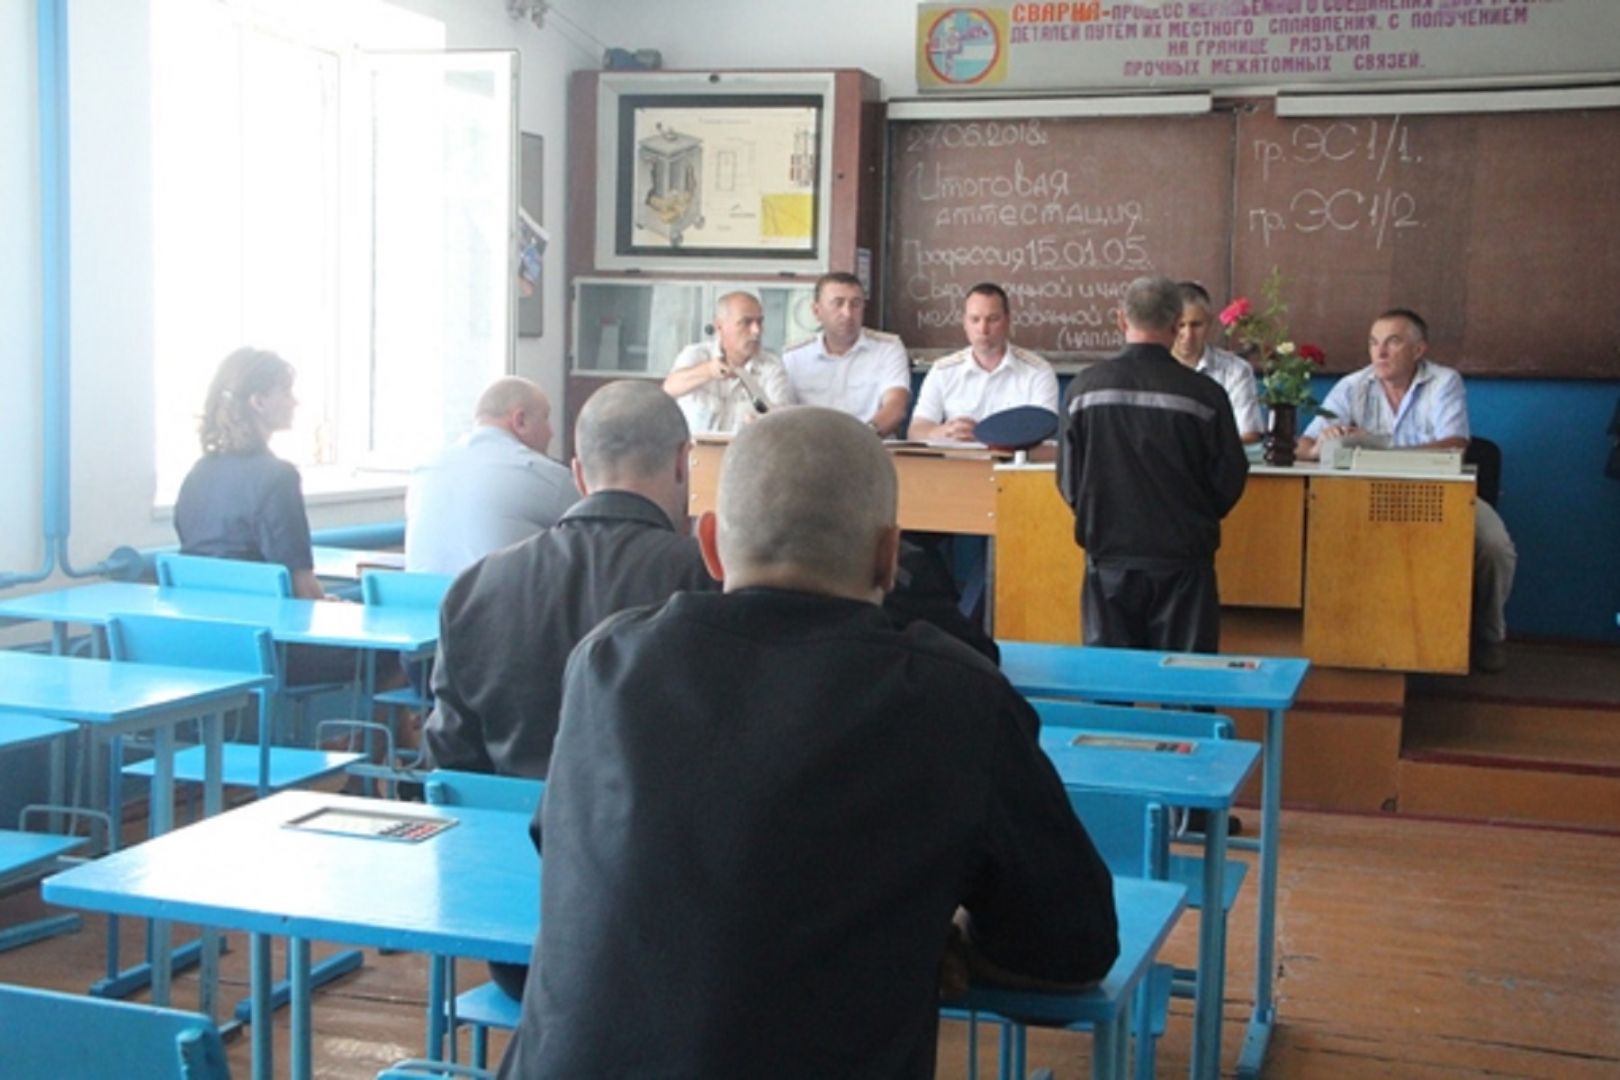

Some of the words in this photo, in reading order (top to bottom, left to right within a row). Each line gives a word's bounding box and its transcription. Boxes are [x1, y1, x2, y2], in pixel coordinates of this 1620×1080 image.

[1142, 23, 1162, 38] ИХ
[1168, 18, 1254, 38] МЕСТНОГО
[1388, 12, 1400, 30] С
[1411, 6, 1528, 29] ПОЛУЧЕНИЕМ
[1168, 40, 1189, 56] НА
[1196, 37, 1269, 56] ГРАНИЦЕ
[1290, 34, 1370, 53] РАЗЪЕМА
[1124, 59, 1200, 76] ПРОЧНЫХ
[1211, 55, 1332, 75] МЕЖАТОМНЫХ
[1253, 138, 1287, 182] гр.
[908, 157, 1070, 201] Итоговая
[1249, 207, 1286, 248] гр.
